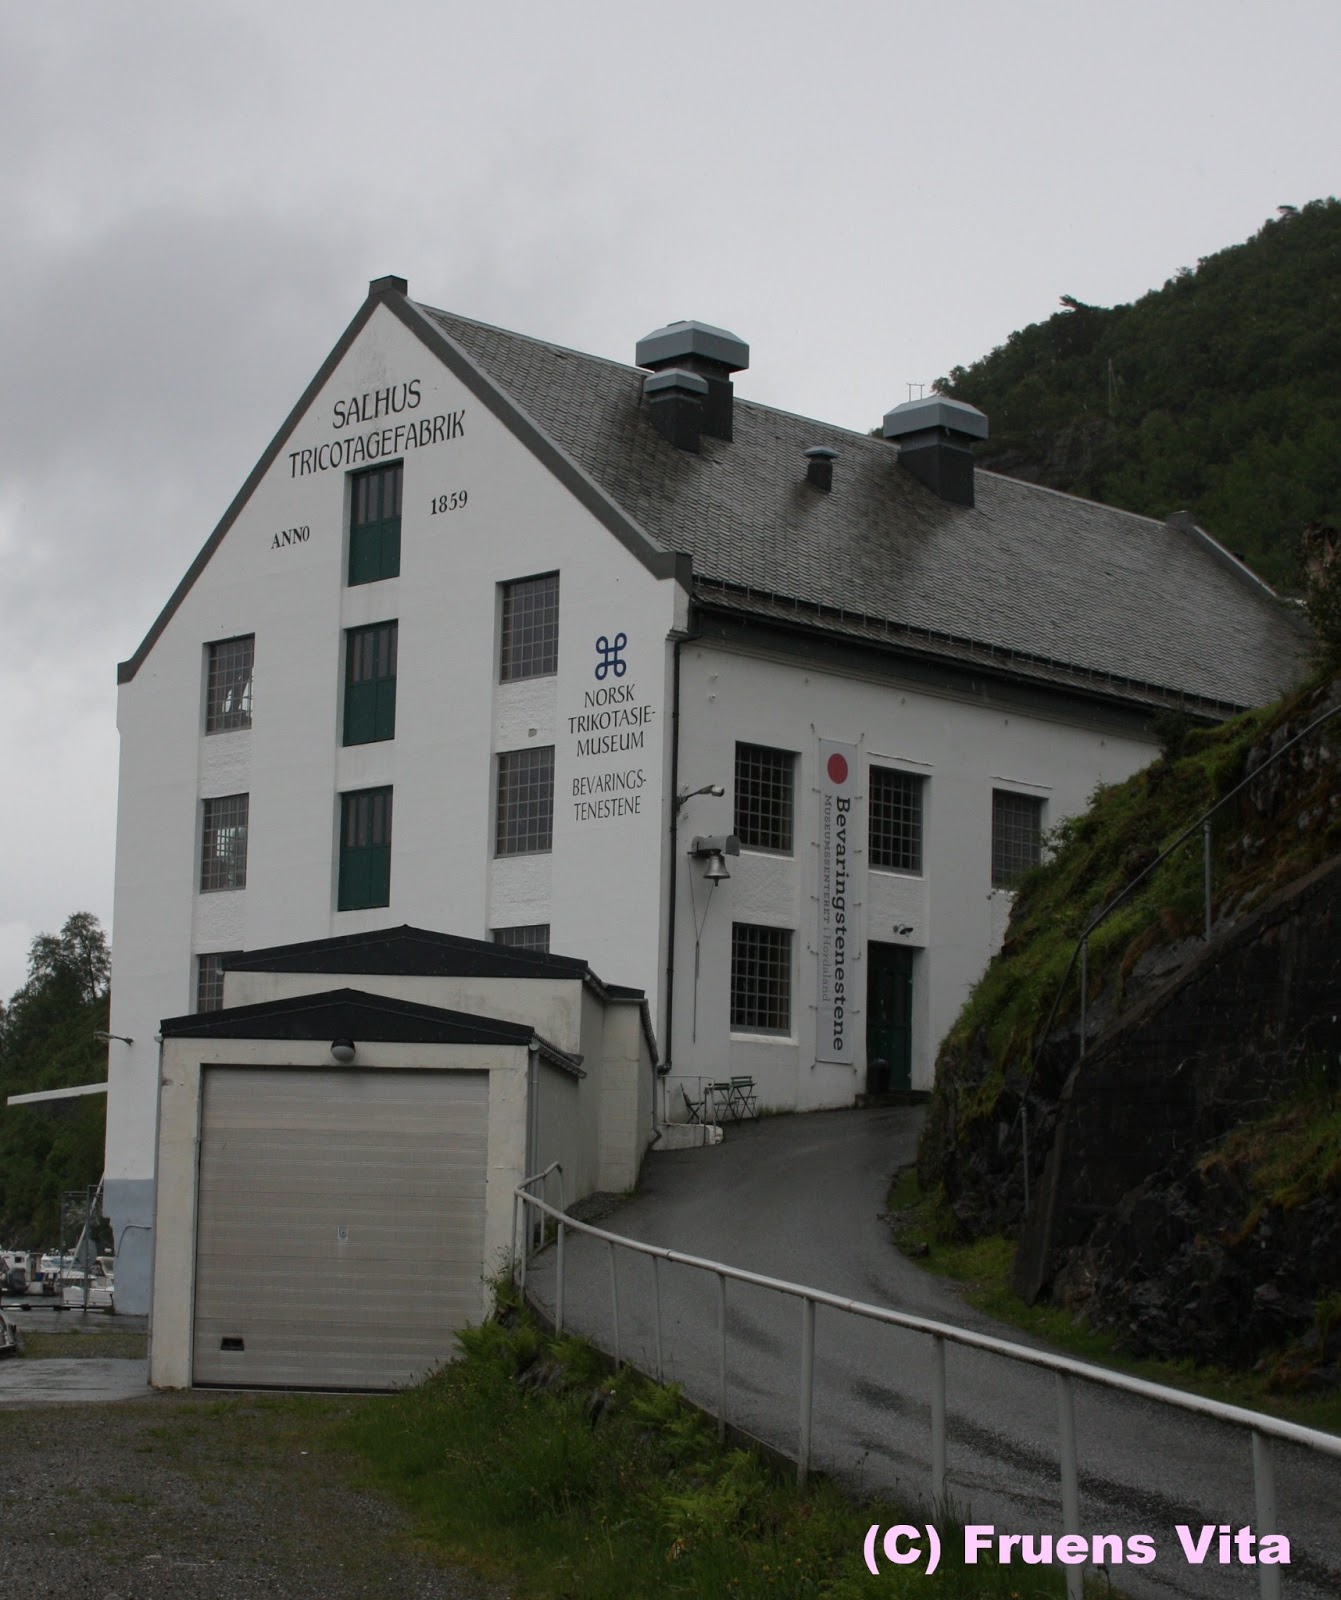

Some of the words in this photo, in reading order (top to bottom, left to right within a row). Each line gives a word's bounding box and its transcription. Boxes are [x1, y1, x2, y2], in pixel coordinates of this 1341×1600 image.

[332, 379, 421, 429] SALHUS
[289, 409, 466, 478] TRICOTAGEFABRIK
[430, 490, 468, 515] 1859
[270, 525, 310, 549] ANNO
[584, 684, 635, 708] NORSK
[568, 705, 656, 734] TRIKOTASJE-
[576, 731, 644, 757] MUSEUM
[572, 769, 647, 796] BEVARINGS-
[574, 796, 641, 821] TENESTENE
[832, 796, 850, 1051] Bevaringstenestene
